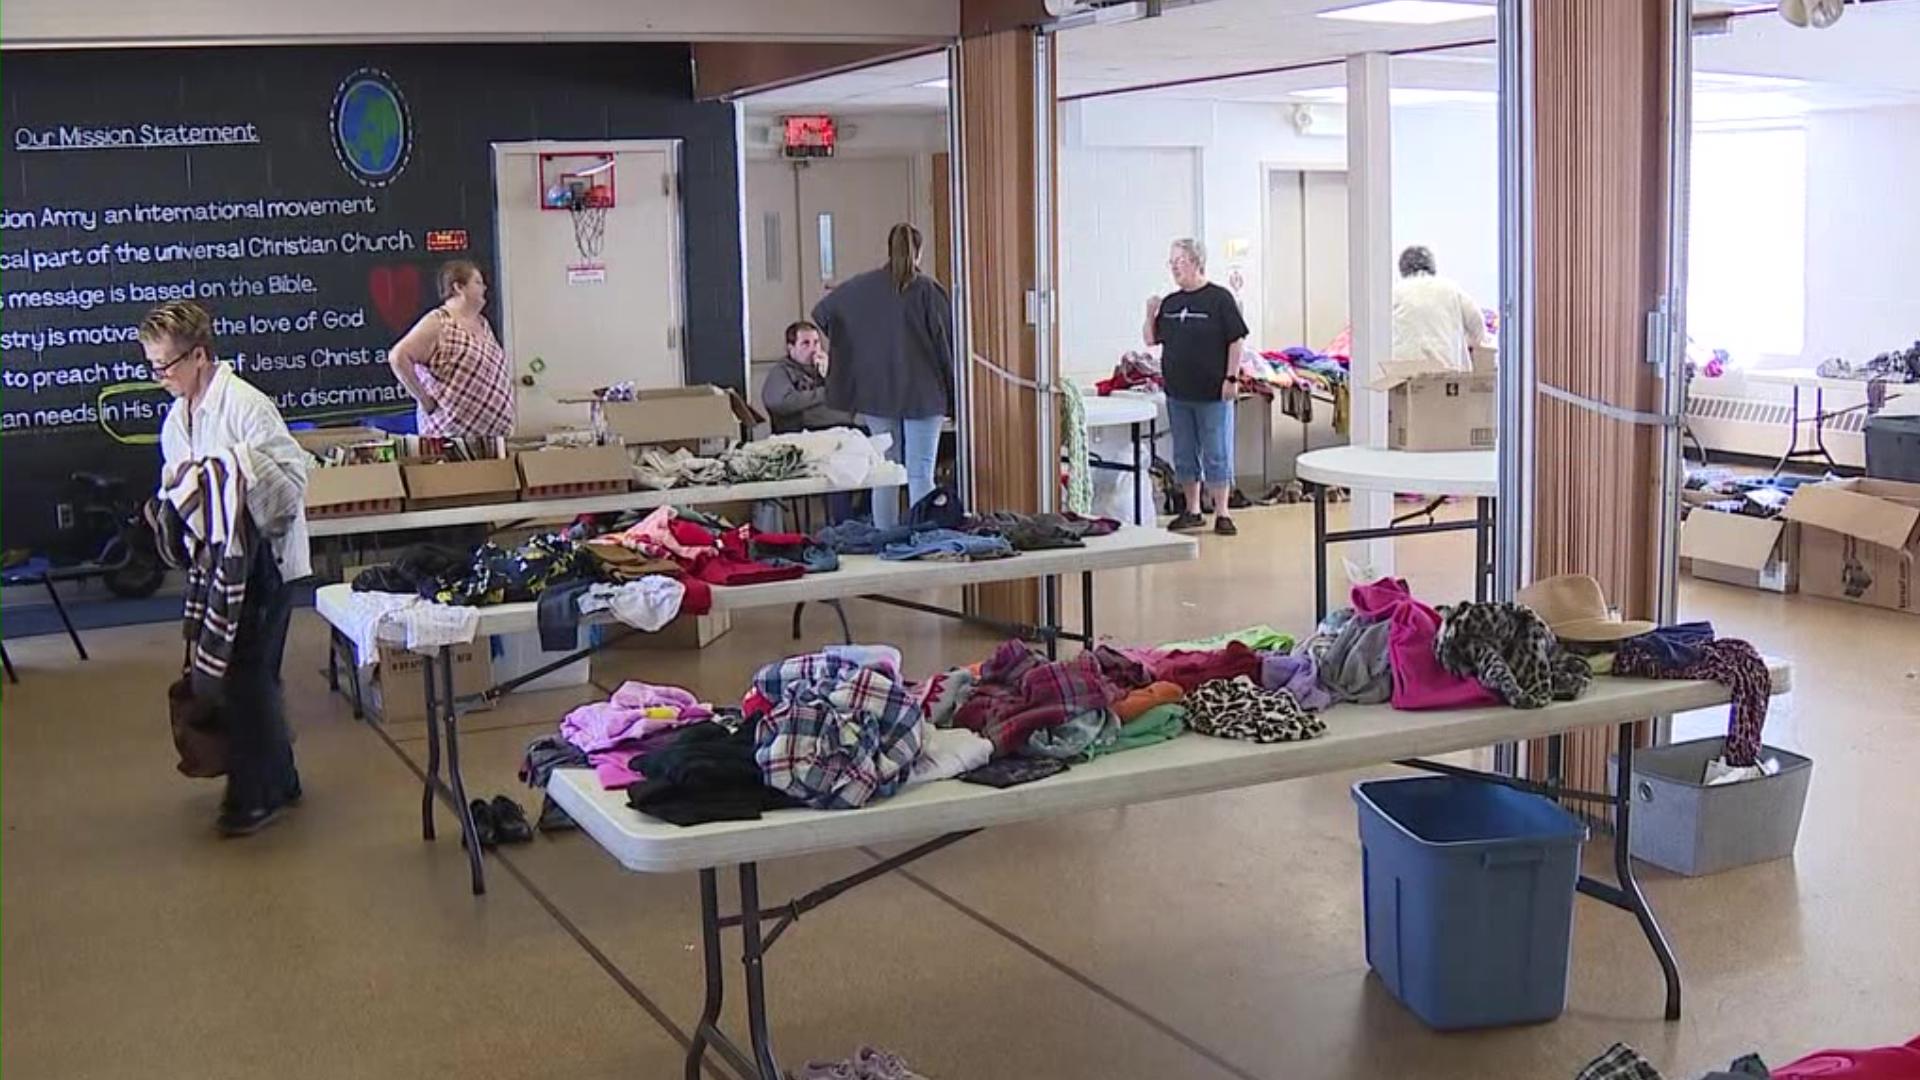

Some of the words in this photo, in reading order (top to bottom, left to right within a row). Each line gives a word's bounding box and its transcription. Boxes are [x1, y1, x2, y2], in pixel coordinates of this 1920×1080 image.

[15, 128, 56, 148] Our
[59, 126, 136, 146] Mission
[139, 123, 260, 144] Statement
[40, 207, 97, 230] Army
[104, 209, 132, 224] an
[267, 196, 376, 218] movement
[33, 249, 83, 272] part
[86, 243, 112, 264] of
[115, 241, 150, 263] the
[154, 238, 245, 263] universal
[248, 235, 338, 257] Christian
[340, 229, 415, 252] Church
[8, 289, 105, 310] message
[109, 284, 126, 303] is
[129, 279, 196, 301] based
[199, 282, 226, 298] on
[228, 274, 265, 297] the
[268, 272, 318, 295] Bible.
[47, 327, 67, 347] is
[68, 325, 140, 344] motiva
[212, 316, 247, 336] the
[250, 315, 291, 334] love
[295, 310, 318, 331] of
[322, 307, 365, 328] God
[2, 370, 29, 388] to
[32, 363, 109, 395] preach
[112, 361, 148, 381] the
[250, 353, 307, 373] Jesus
[310, 347, 370, 369] Christ
[0, 412, 30, 429] an
[34, 403, 98, 426] needs
[103, 403, 119, 421] in
[123, 399, 153, 421] His
[300, 383, 411, 408] discriminat
